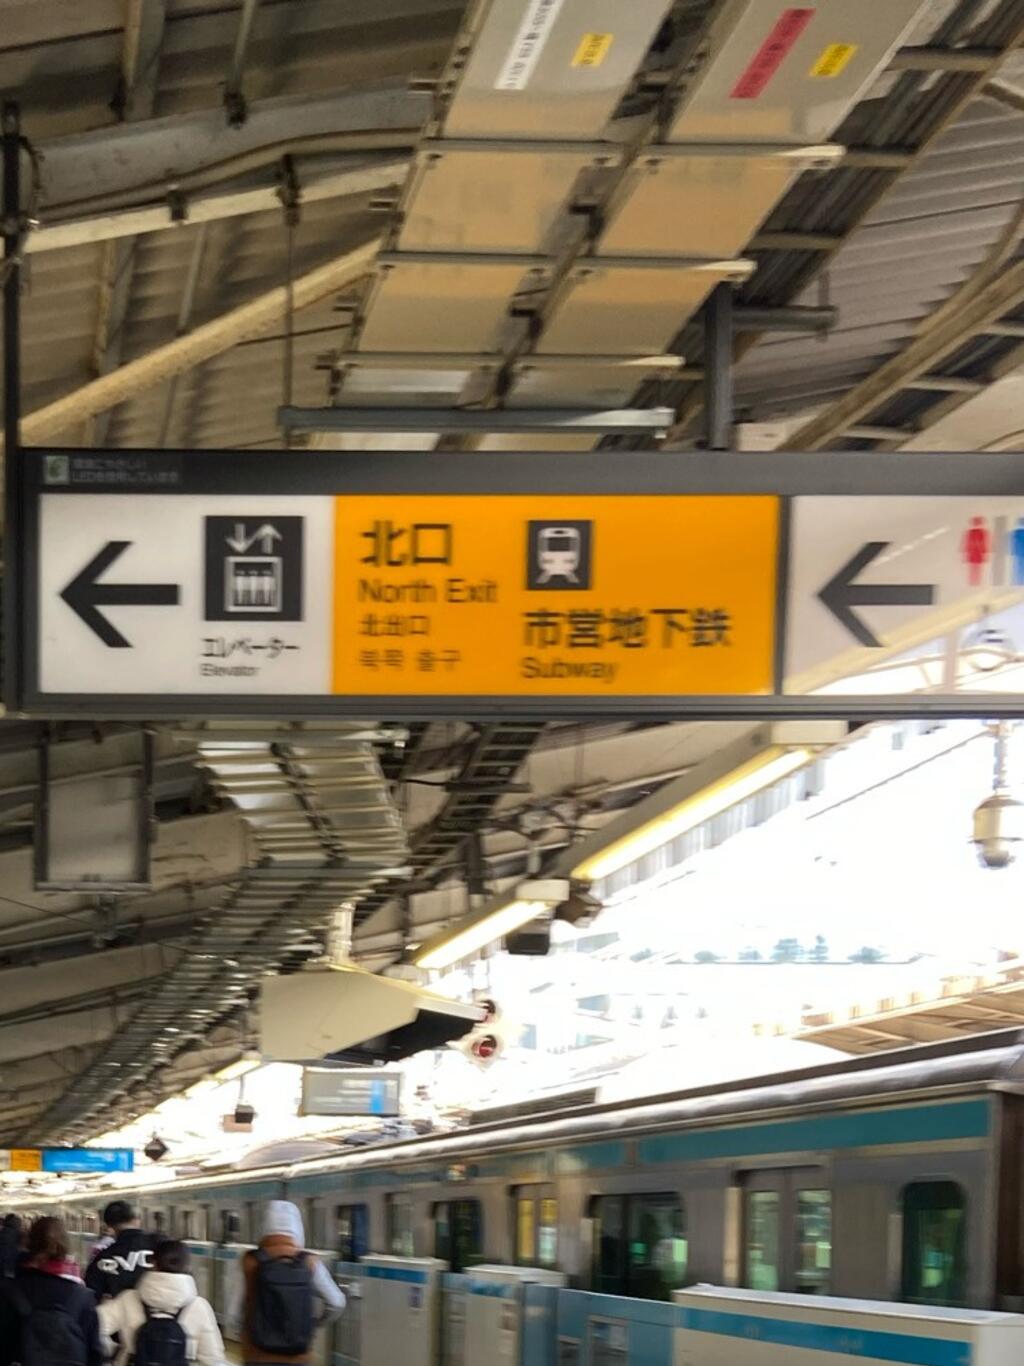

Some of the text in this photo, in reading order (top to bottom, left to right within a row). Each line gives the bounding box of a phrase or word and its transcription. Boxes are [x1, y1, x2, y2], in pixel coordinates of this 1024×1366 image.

[359, 520, 452, 567] 北口
[358, 577, 498, 603] North Exit
[360, 614, 429, 637] 北出口
[522, 608, 732, 648] 市営地下鉄
[201, 637, 301, 659] エレベーター
[521, 656, 619, 683] Subway
